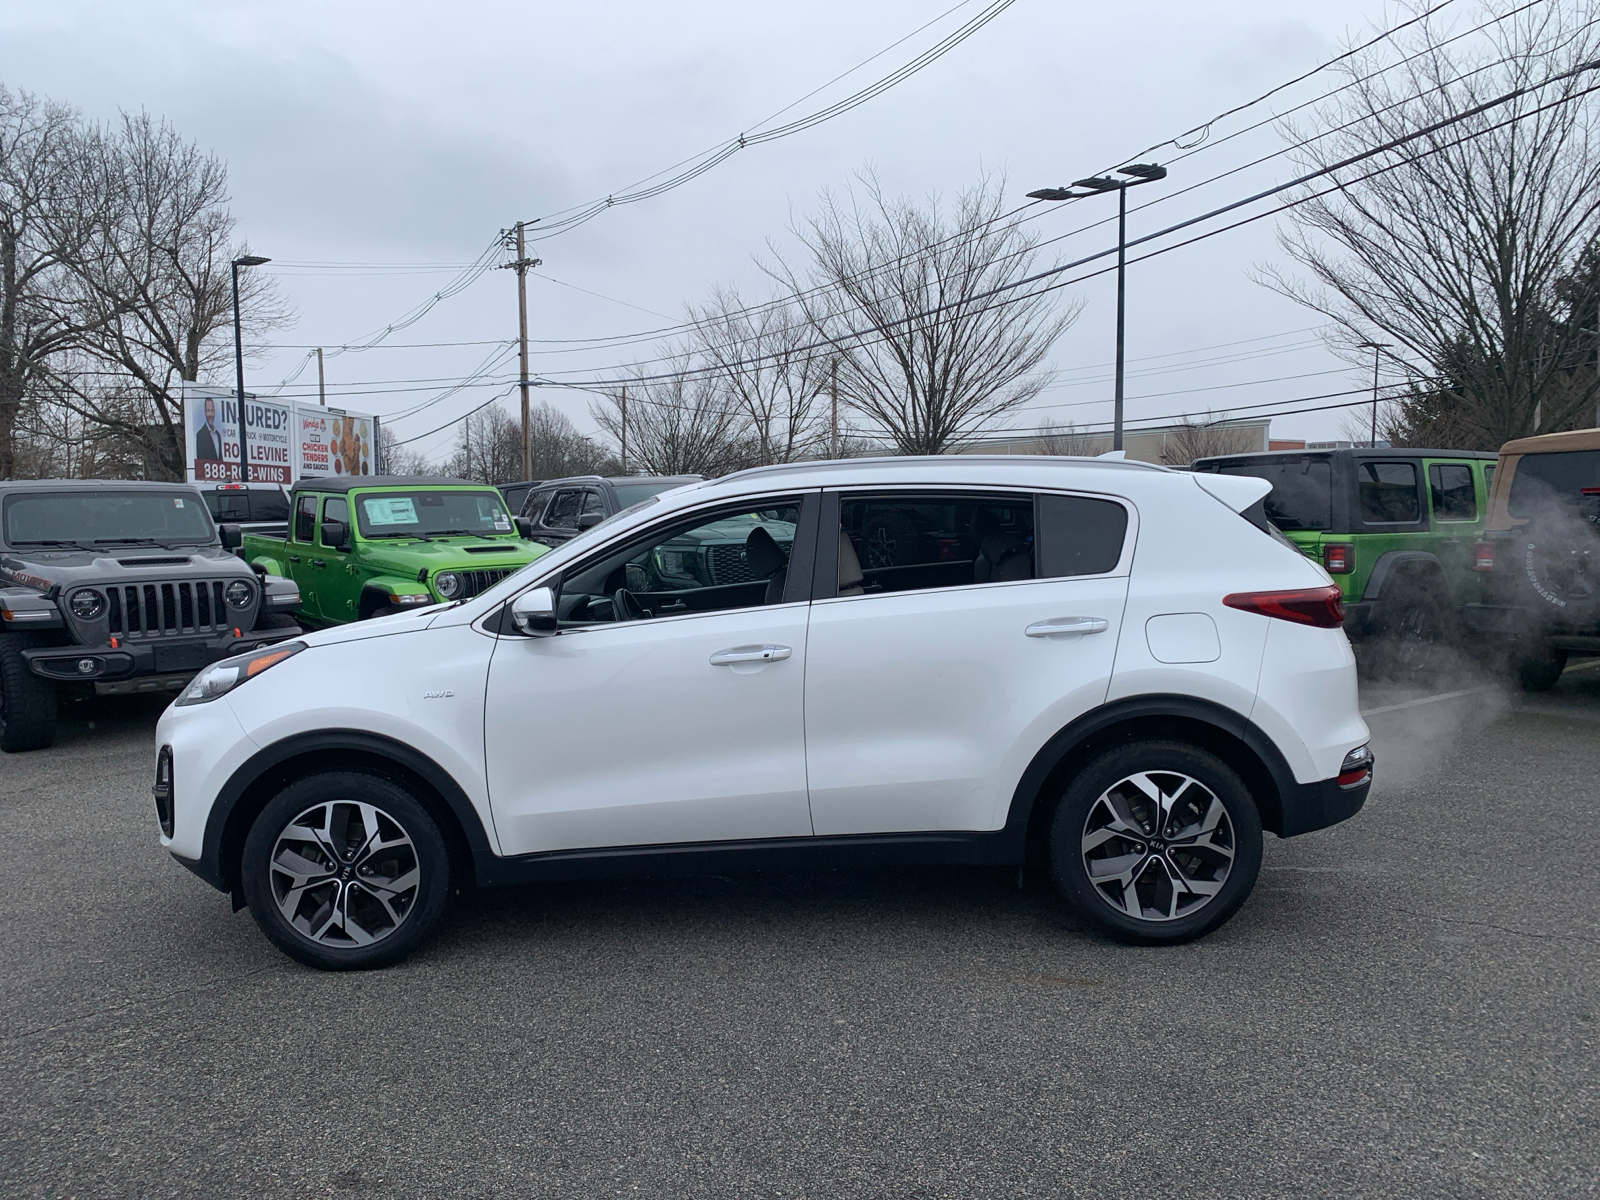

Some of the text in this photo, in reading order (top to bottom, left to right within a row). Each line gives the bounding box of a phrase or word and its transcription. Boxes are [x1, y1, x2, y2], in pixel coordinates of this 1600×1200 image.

[221, 400, 288, 431] INURED?
[227, 429, 288, 443] CAR RUCK MOTORCYCLE
[310, 434, 320, 442] NEW
[223, 442, 288, 462] RO LEVINE
[302, 442, 328, 452] CHICKEN
[302, 452, 328, 462] TENDERS
[11, 571, 51, 588] MOJAVE
[423, 689, 455, 699] AWD
[1149, 840, 1164, 850] KIA
[341, 866, 352, 880] KIA
